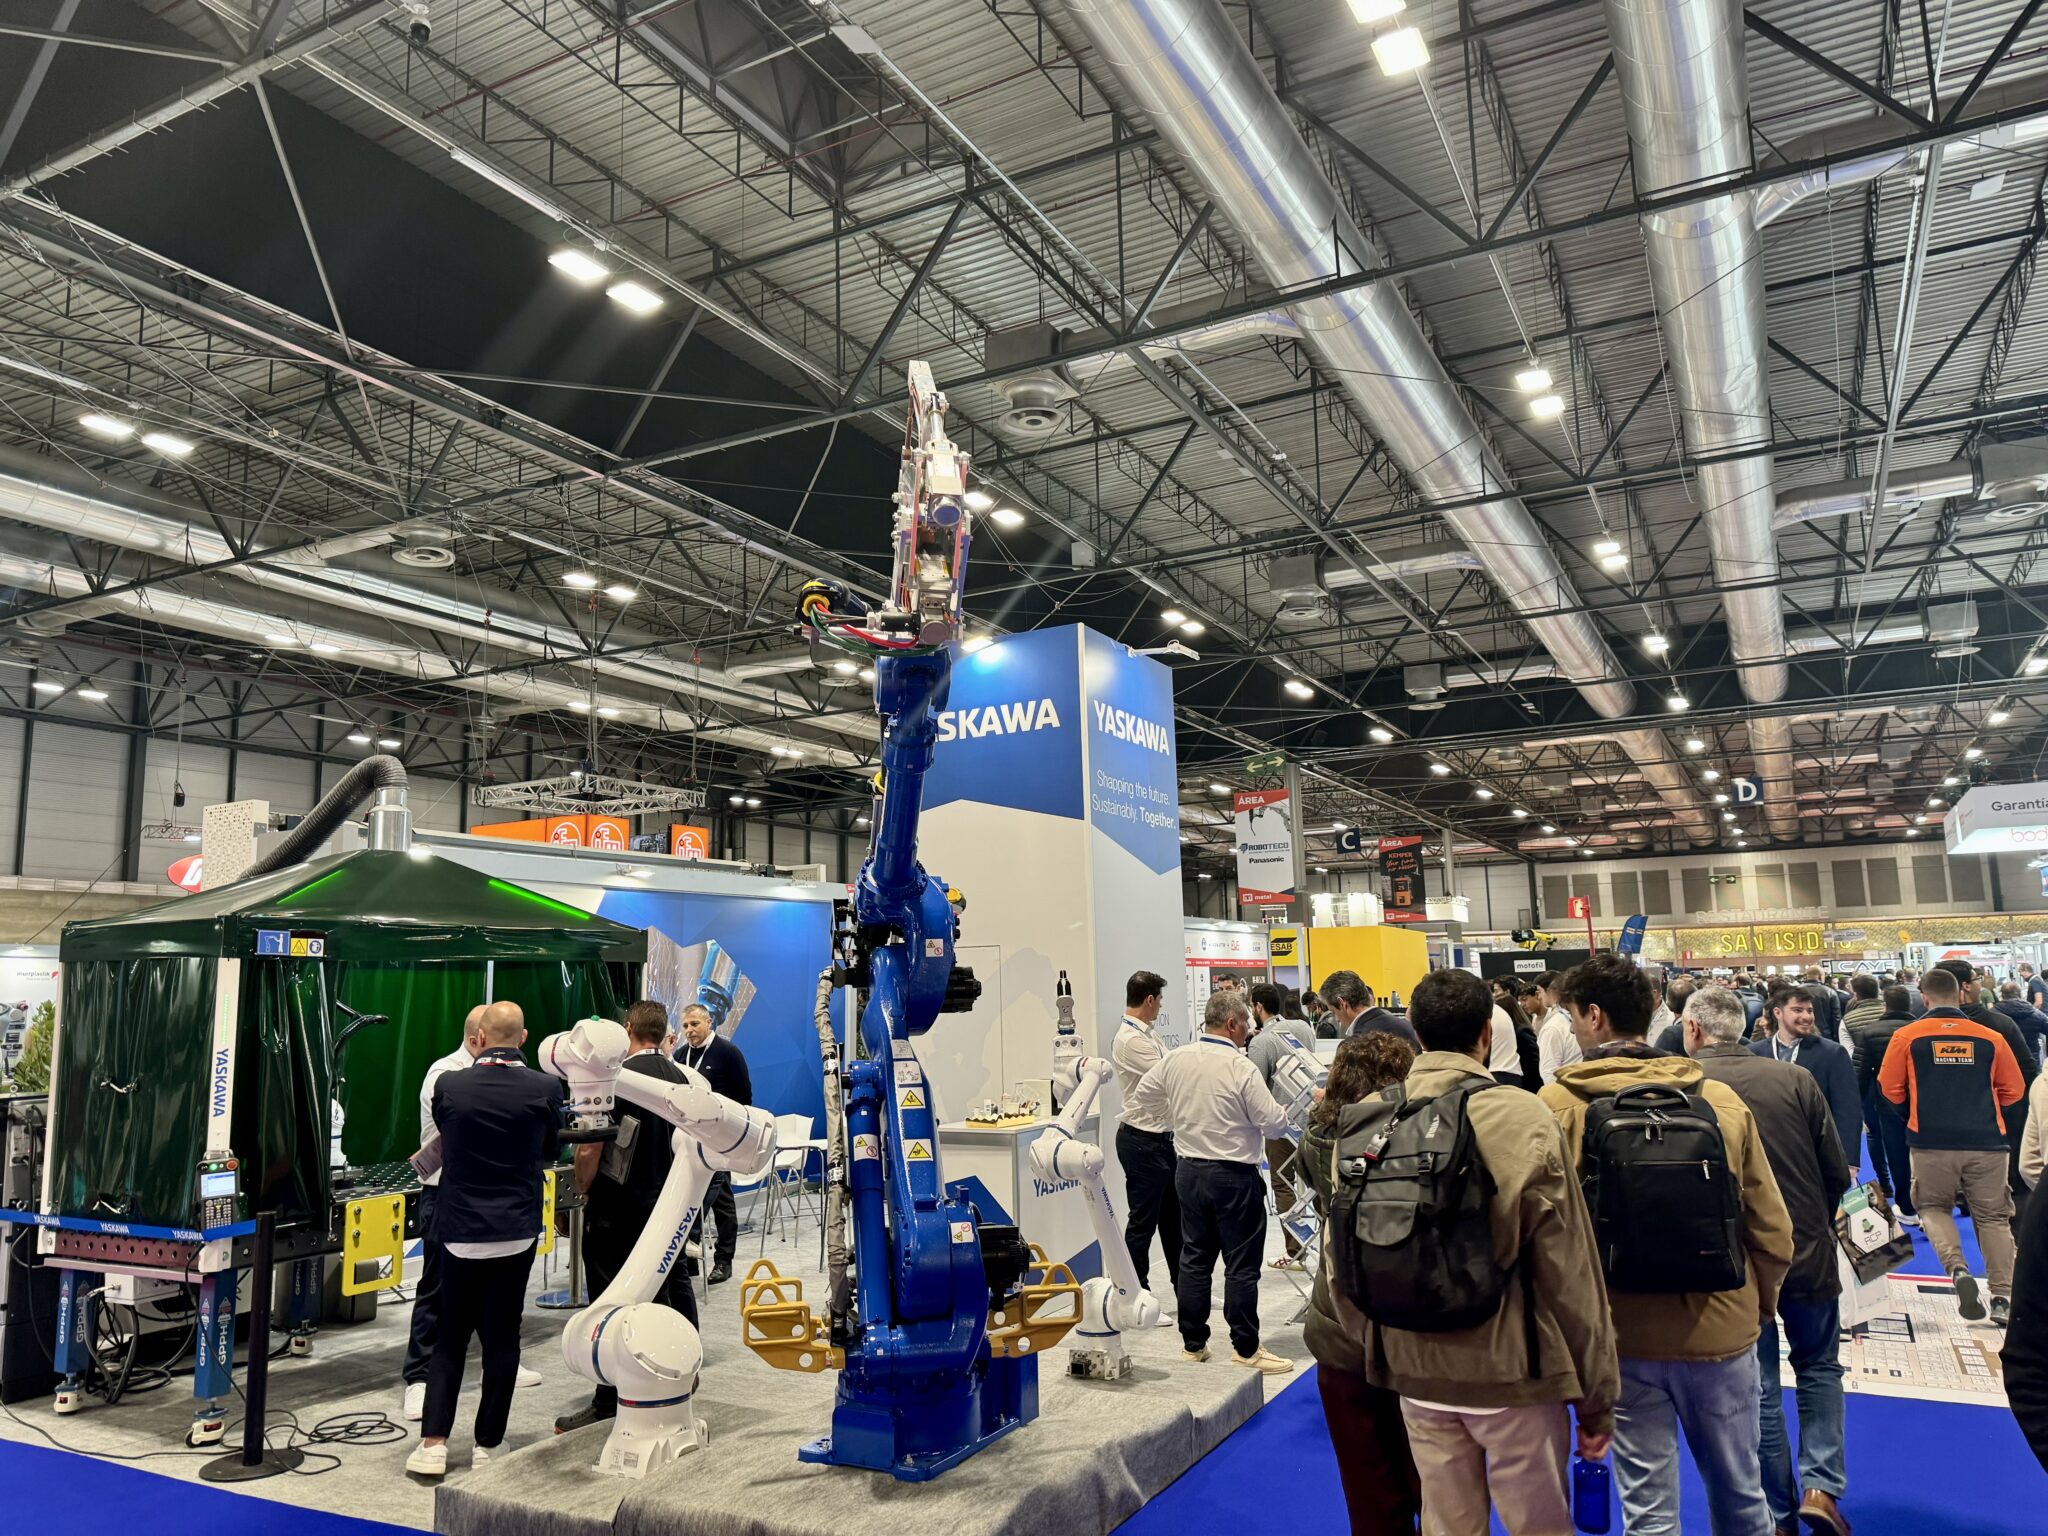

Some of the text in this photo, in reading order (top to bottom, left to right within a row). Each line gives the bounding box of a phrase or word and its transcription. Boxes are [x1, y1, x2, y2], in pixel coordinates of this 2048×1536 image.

[935, 698, 1061, 742] SKAWA
[1094, 699, 1170, 756] YASKAWA
[1097, 769, 1170, 805] Shapping the future.
[1736, 780, 1757, 802] D
[1238, 795, 1265, 806] ÁREA
[1091, 793, 1177, 830] Sustainably. Together.
[1248, 842, 1289, 851] ROBOTECO
[1341, 831, 1356, 850] C
[1249, 855, 1285, 864] Panasonic
[1271, 943, 1293, 951] ESAB
[1721, 933, 1764, 952] SAN
[1516, 961, 1544, 971] motofil
[1940, 1046, 1967, 1054] KTM
[211, 1048, 229, 1118] YASKAWA
[33, 1214, 61, 1227] YASKAWA
[100, 1222, 130, 1235] YASKAWA
[172, 1229, 204, 1241] YASKAWA
[656, 1206, 698, 1276] YASKAWA
[218, 1324, 229, 1365] GPPH
